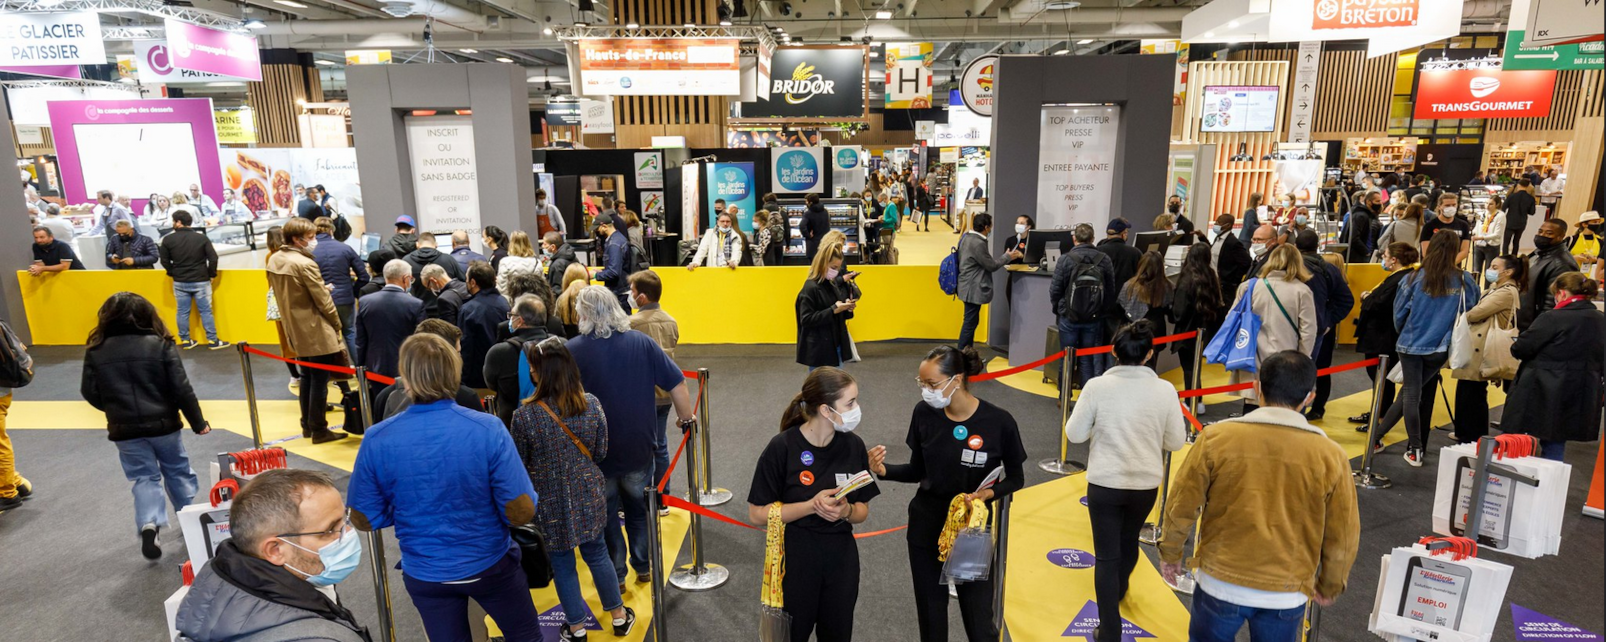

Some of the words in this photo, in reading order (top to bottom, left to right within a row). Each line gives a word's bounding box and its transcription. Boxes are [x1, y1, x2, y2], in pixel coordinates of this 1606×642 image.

[20, 24, 85, 39] GLACIER
[11, 45, 80, 60] PATISSIER
[585, 48, 686, 62] Hauts-de-France
[772, 80, 835, 94] BRIDOR
[898, 68, 920, 94] H
[104, 106, 138, 115] compagnie
[1431, 100, 1534, 112] TRANSGOURMET
[1050, 116, 1066, 124] TOP
[1068, 116, 1110, 124] ACHETEUR
[426, 128, 458, 137] INSCRIT
[438, 143, 451, 152] OU
[422, 158, 470, 166] INVITATION
[420, 173, 445, 182] SANS
[446, 172, 476, 181] BADGE
[1417, 596, 1447, 609] EMPLOI
